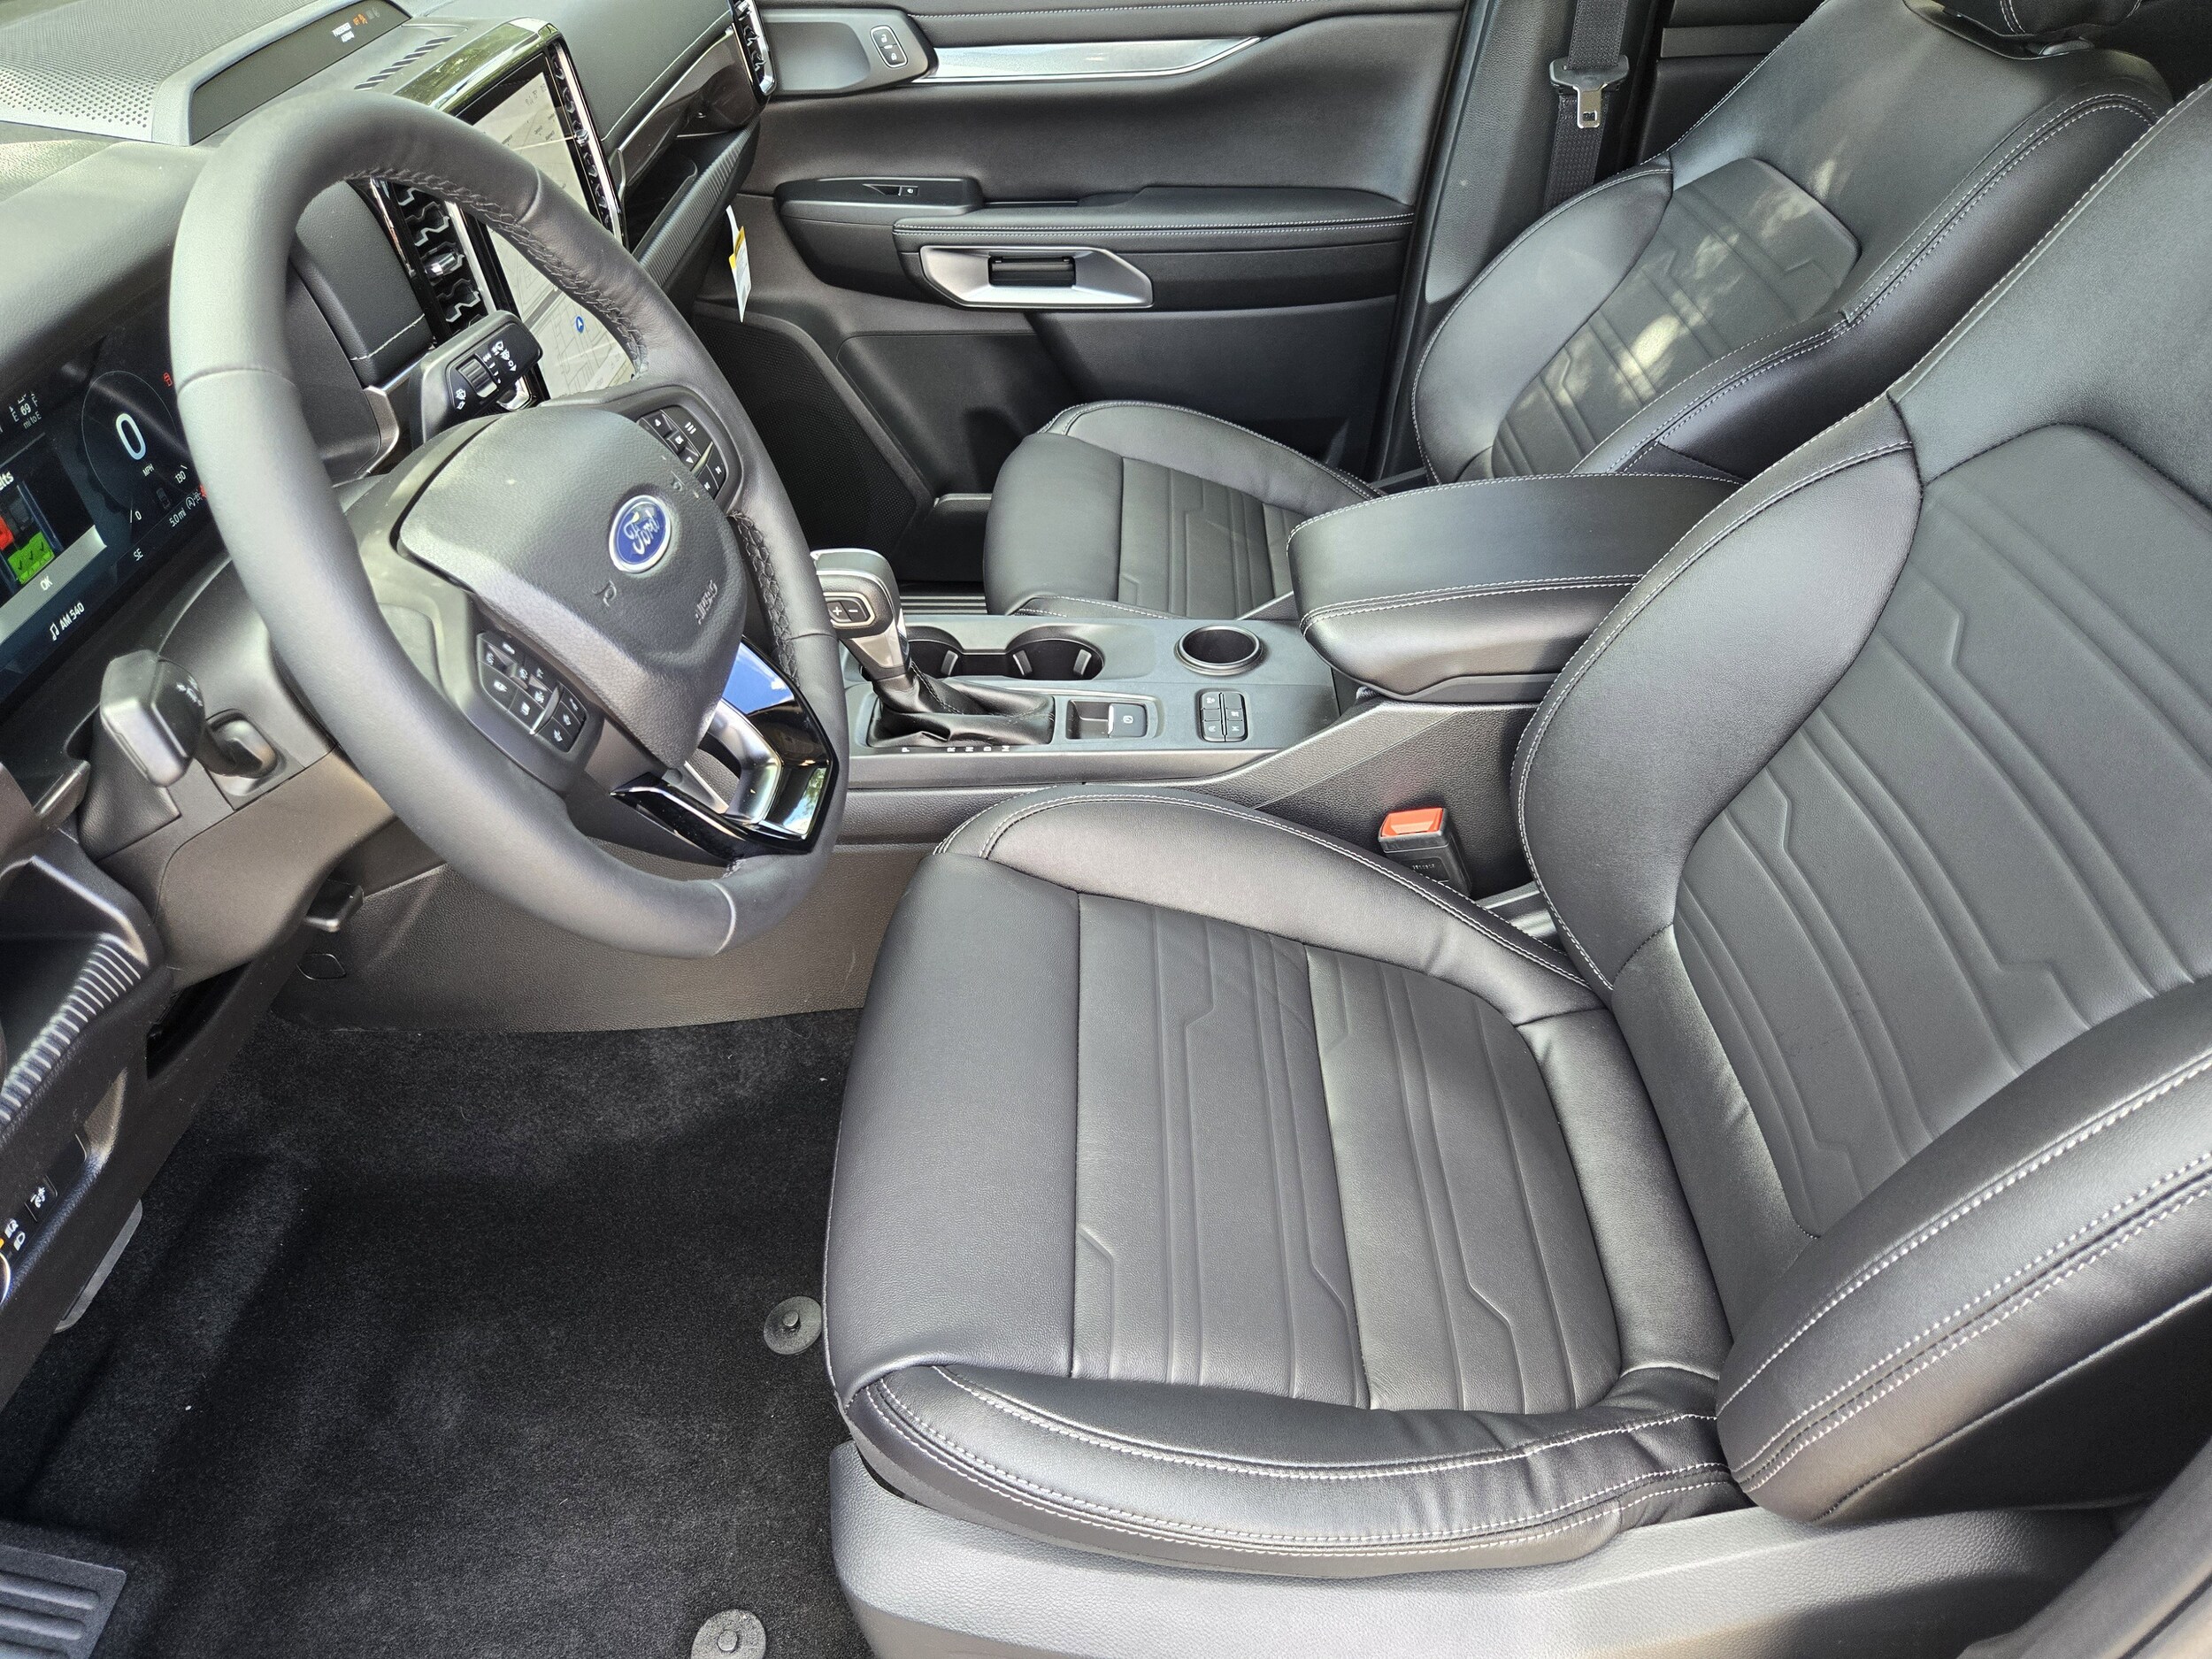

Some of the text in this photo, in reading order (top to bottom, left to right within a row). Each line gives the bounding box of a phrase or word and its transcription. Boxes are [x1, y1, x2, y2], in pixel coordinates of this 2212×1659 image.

[12, 411, 19, 422] E
[19, 403, 32, 416] 69
[29, 416, 37, 425] to
[35, 411, 42, 420] E
[115, 412, 146, 460] 0
[142, 463, 155, 477] MPH
[174, 471, 186, 484] 130
[134, 511, 142, 520] 0
[623, 508, 660, 555] Ford
[133, 548, 143, 561] SE
[40, 575, 53, 591] OK
[59, 602, 85, 631] AM 540
